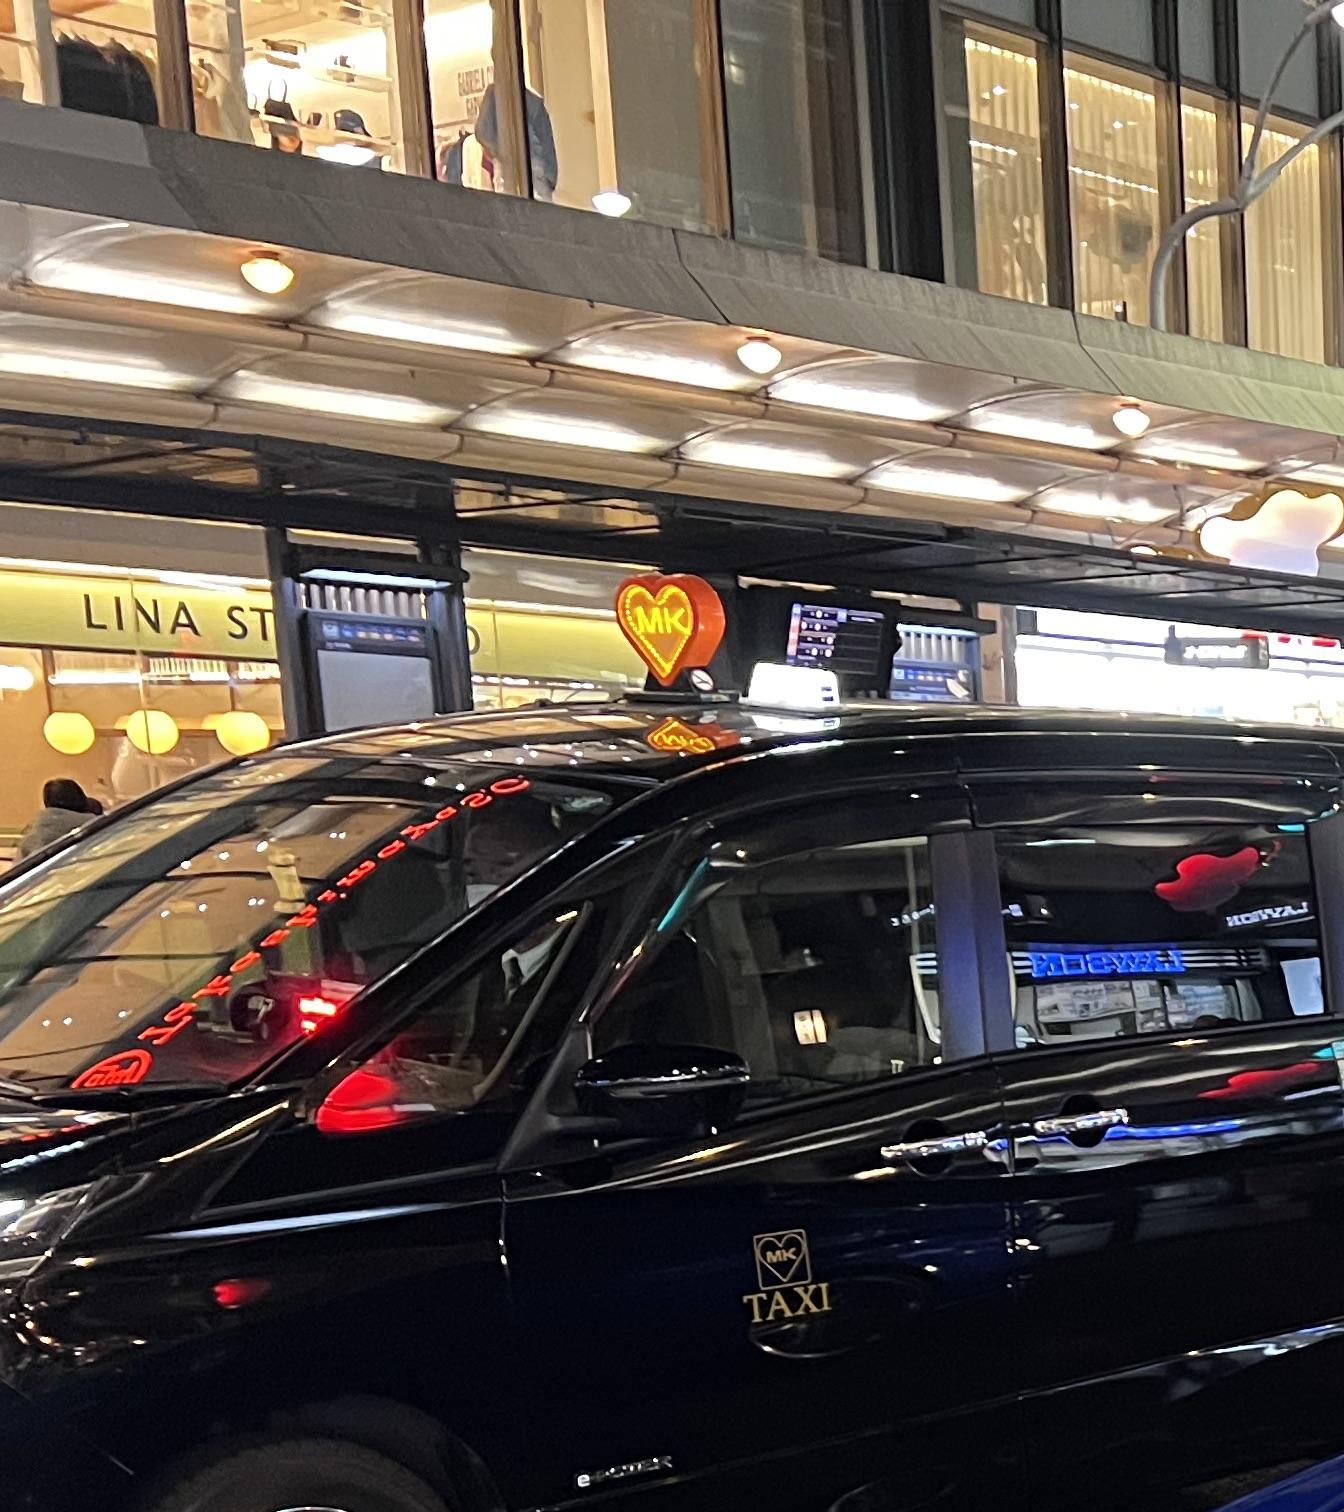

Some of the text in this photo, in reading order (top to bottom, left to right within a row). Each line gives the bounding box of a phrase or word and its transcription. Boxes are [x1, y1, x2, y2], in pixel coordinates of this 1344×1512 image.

[83, 593, 201, 637] LINA
[635, 606, 691, 635] MK
[766, 1247, 798, 1263] MK
[742, 1283, 833, 1323] TAXI
